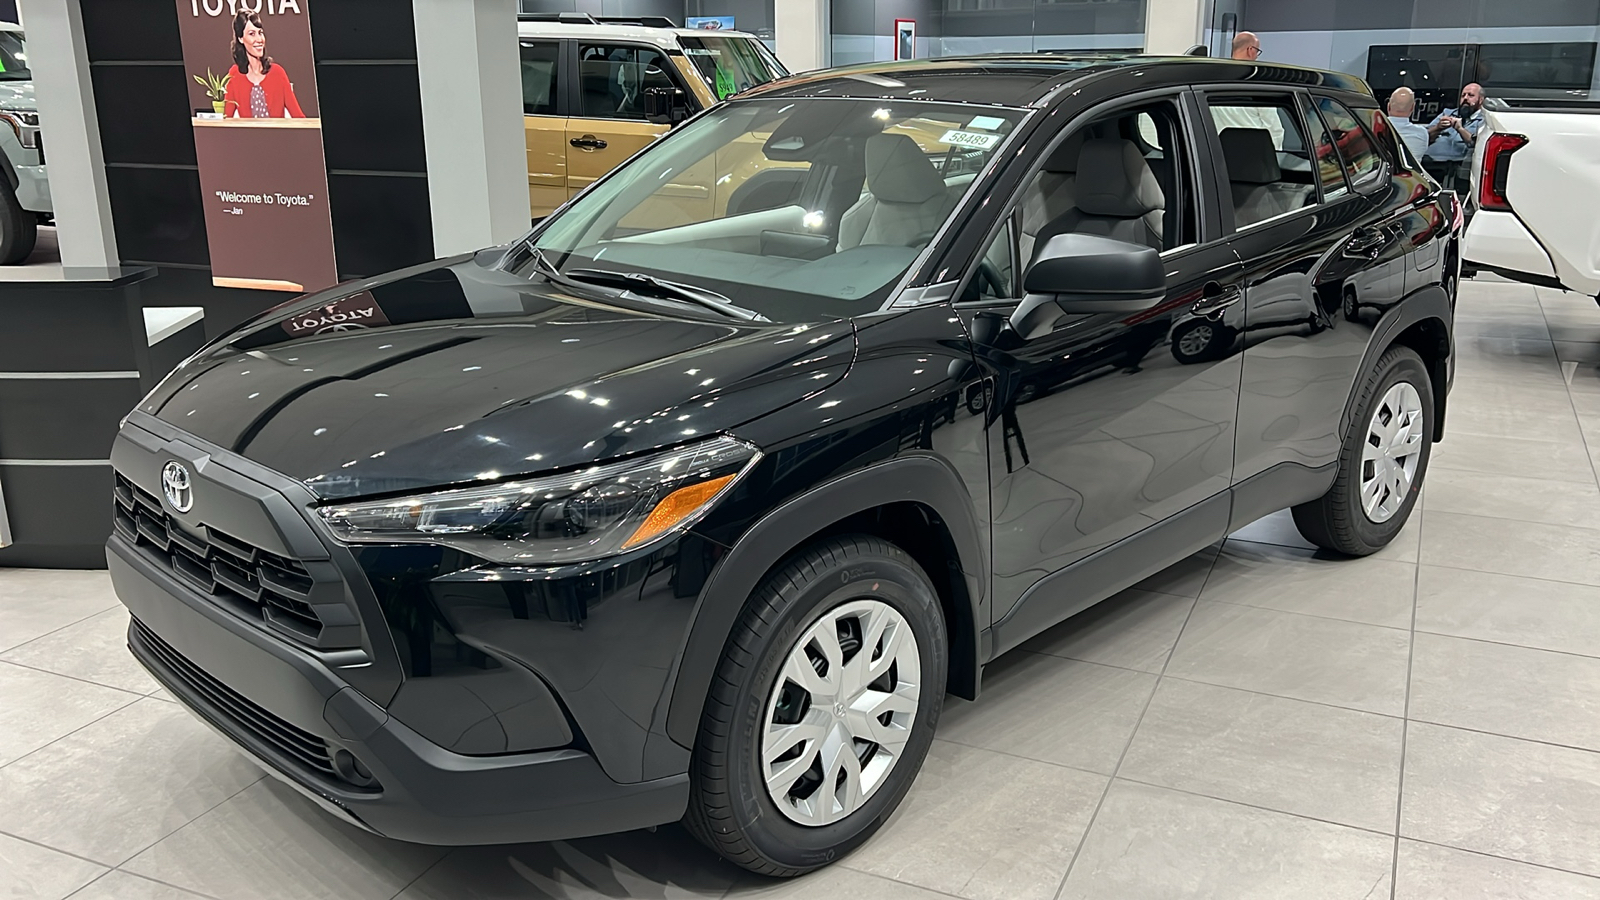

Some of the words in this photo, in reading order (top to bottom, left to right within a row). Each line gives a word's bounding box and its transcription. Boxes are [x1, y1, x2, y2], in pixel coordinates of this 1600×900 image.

[190, 0, 301, 17] TOYOTA
[948, 132, 989, 146] 58489
[262, 193, 274, 204] to
